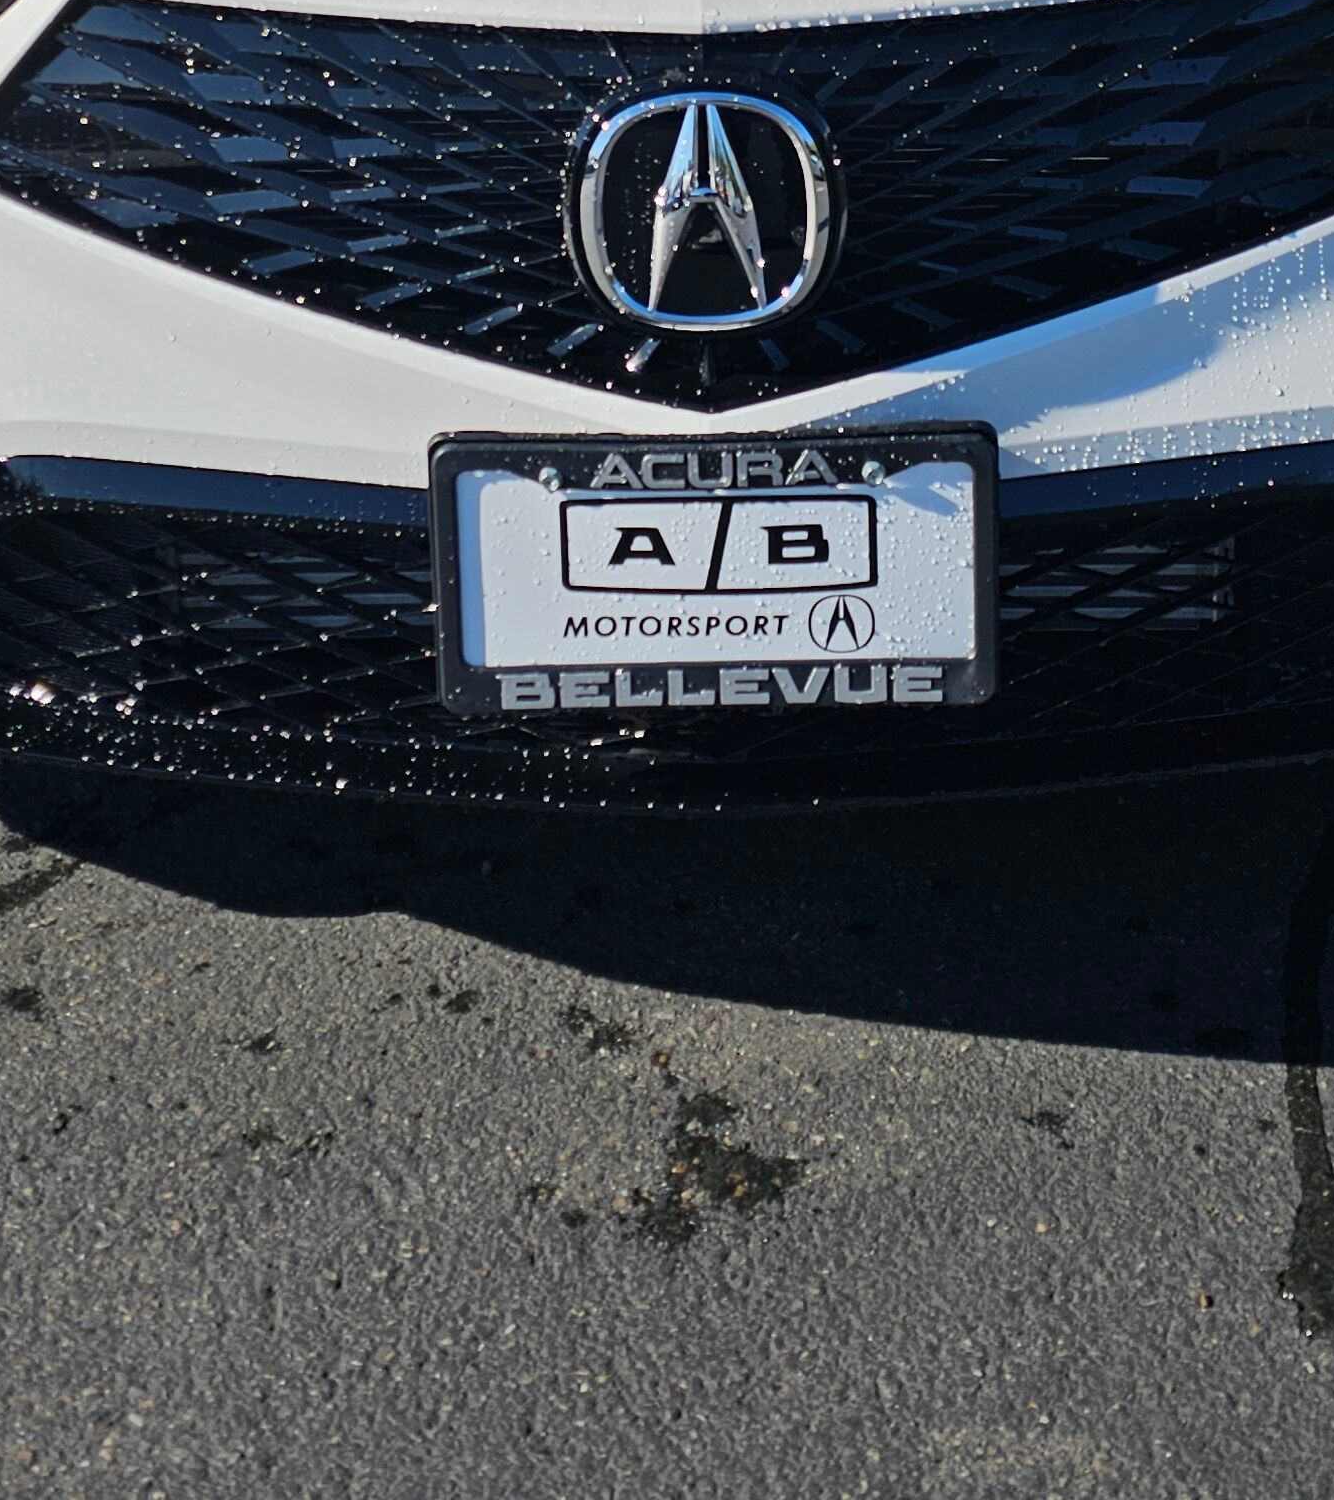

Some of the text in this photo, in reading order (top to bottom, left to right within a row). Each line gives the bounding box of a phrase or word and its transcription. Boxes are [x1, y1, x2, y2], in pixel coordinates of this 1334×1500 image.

[591, 449, 838, 489] ACURA
[608, 524, 829, 566] A B
[563, 614, 790, 639] MOTORSPORT
[496, 667, 945, 710] BELLEVUE
